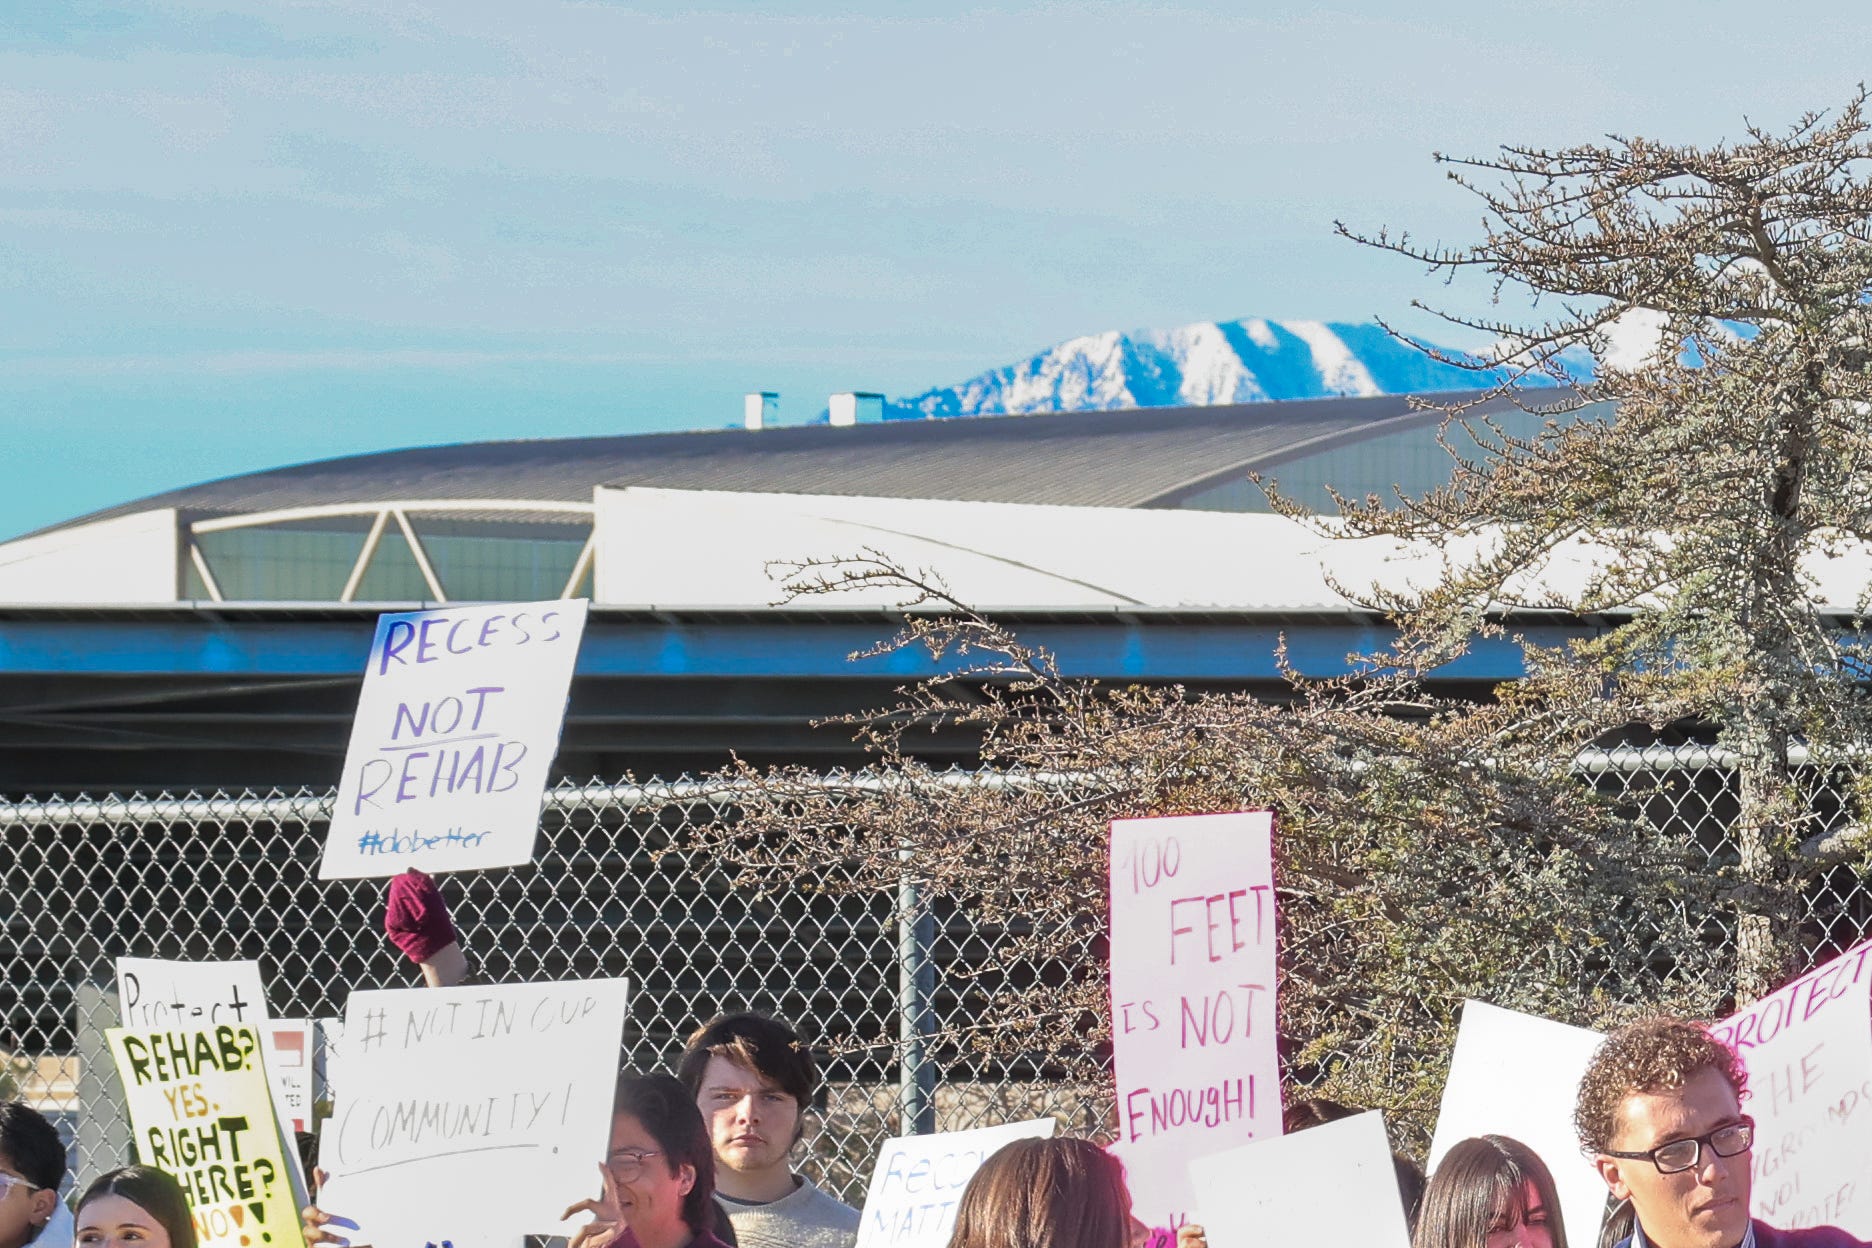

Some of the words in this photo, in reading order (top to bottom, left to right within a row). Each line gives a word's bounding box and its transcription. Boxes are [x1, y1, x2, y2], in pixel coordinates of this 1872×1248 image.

[379, 611, 561, 676] RECESS
[391, 686, 505, 740] NOT
[354, 741, 528, 817] REHAB
[357, 826, 492, 856] #dobetter
[1121, 836, 1181, 895] 100
[1170, 885, 1270, 966] FEET
[472, 999, 517, 1040] IN
[1121, 1000, 1160, 1035] IS
[1181, 983, 1266, 1050] NOT
[122, 1025, 254, 1086] REHAB?
[163, 1082, 221, 1121] YES.
[148, 1116, 249, 1170] RIGHT
[176, 1158, 275, 1207] HERE?
